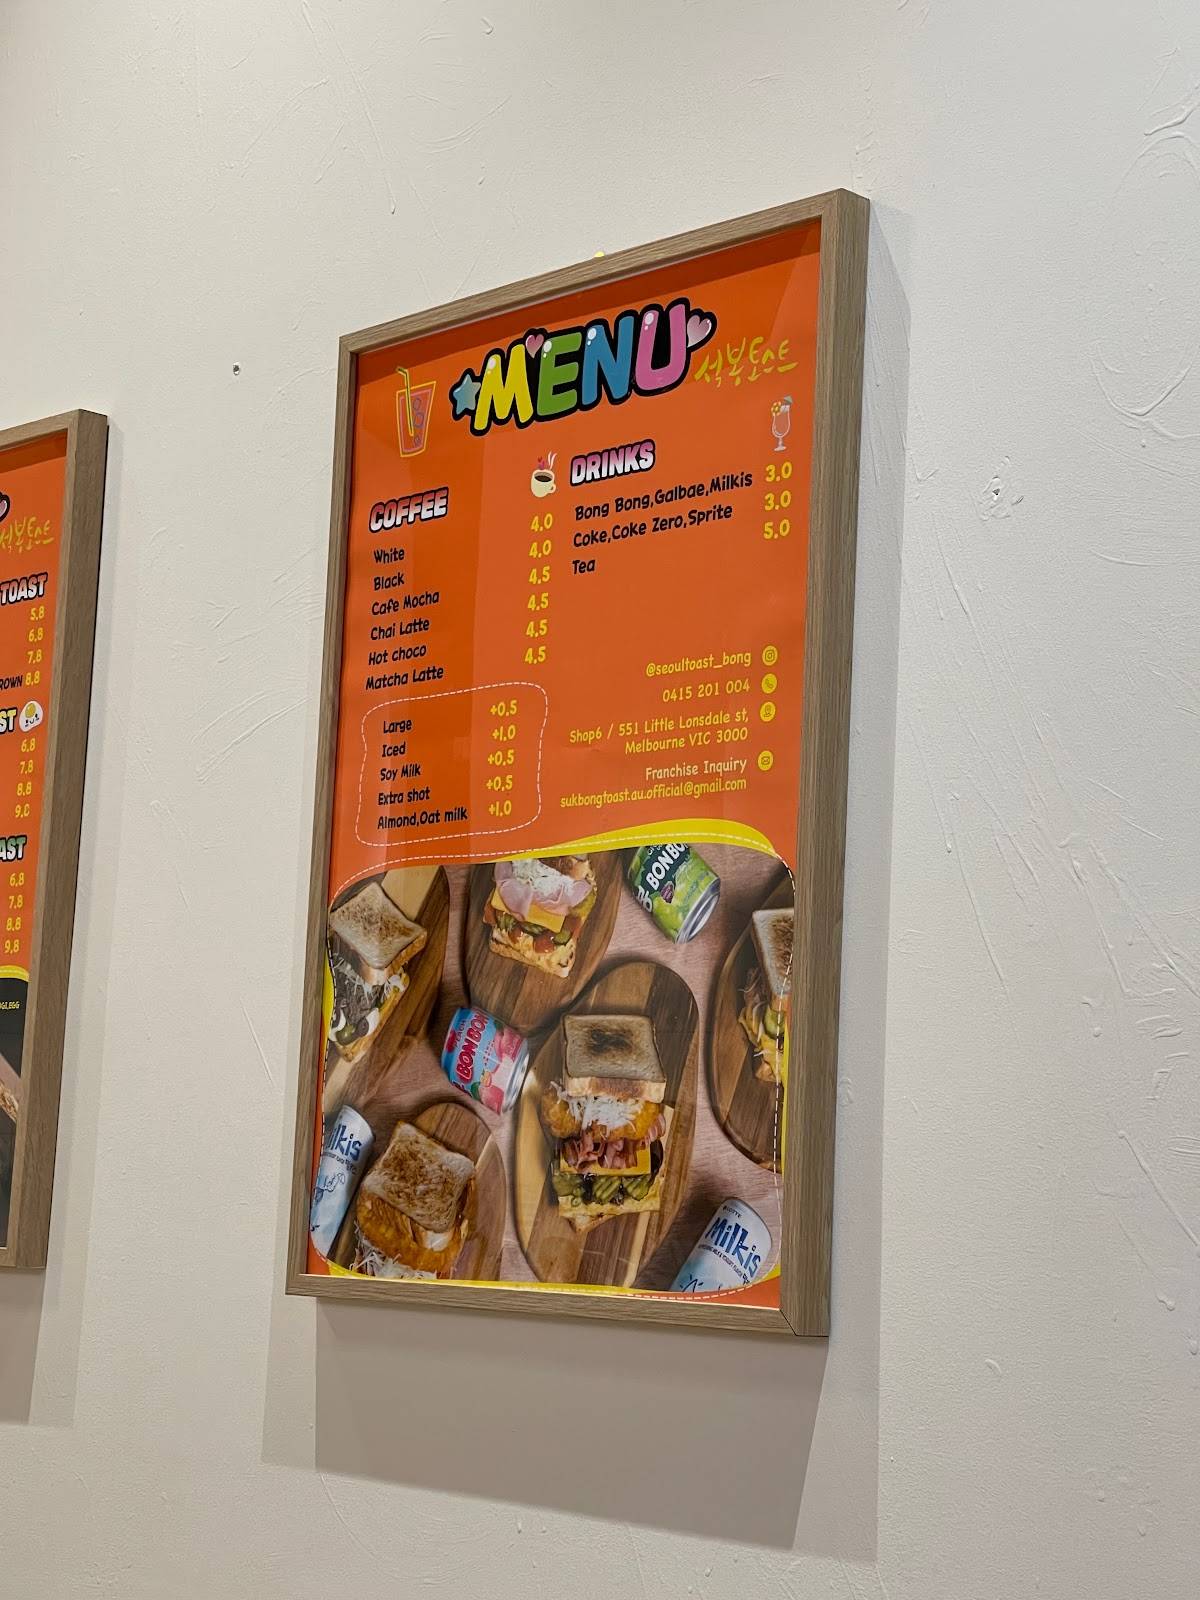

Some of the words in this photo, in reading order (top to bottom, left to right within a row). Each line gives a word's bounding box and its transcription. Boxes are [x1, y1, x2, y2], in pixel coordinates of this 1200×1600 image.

[470, 298, 690, 436] MENU
[570, 438, 656, 486] DRINKS
[765, 461, 793, 482] 3.0
[764, 490, 792, 511] 3.0
[369, 487, 449, 533] COFFEE
[575, 501, 610, 521] Bong
[530, 513, 553, 532] 4.0
[763, 519, 790, 539] 5.0
[374, 547, 405, 564] White
[529, 540, 552, 558] 4.0
[528, 566, 551, 585] 4.5
[572, 559, 596, 575] Tea
[0, 572, 48, 605] TOAST
[373, 572, 405, 591] Black
[371, 599, 400, 616] Cafe
[403, 591, 440, 609] Mocha
[527, 593, 549, 611] 4.5
[30, 605, 45, 621] 5.8
[28, 627, 43, 643] 6.8
[370, 623, 396, 641] Chai
[399, 618, 430, 636] Latte
[525, 619, 548, 637] 4.5
[27, 649, 42, 664] 7.8
[368, 650, 388, 666] Hot
[392, 645, 427, 661] choco
[524, 646, 546, 664] 4.5
[645, 652, 751, 678] @seoultoast_bong
[25, 670, 40, 686] 8.8
[365, 671, 408, 691] Matcha
[413, 666, 444, 683] Latte
[663, 686, 692, 703] 0415
[697, 682, 719, 698] 201
[726, 679, 750, 695] 004
[490, 700, 518, 717] +0.5
[383, 719, 412, 734] Large
[492, 725, 516, 742] +1.0
[569, 726, 602, 746] Shop6
[607, 723, 614, 740] /
[619, 722, 639, 738] 551
[644, 718, 675, 734] Little
[679, 711, 730, 729] Lonsdale
[735, 707, 749, 723] st,
[21, 738, 36, 753] 6.8
[381, 742, 406, 758] Iced
[625, 736, 685, 755] Melbourne
[688, 732, 711, 747] VIC
[717, 727, 748, 744] 3000
[19, 760, 33, 774] 7.8
[487, 750, 515, 766] +0.5
[380, 768, 397, 782] Soy
[401, 764, 421, 778] Milk
[645, 763, 699, 781] Franchise
[703, 757, 747, 777] Inquiry
[16, 782, 32, 797] 8.8
[486, 775, 513, 791] +0.5
[378, 791, 404, 806] Extra
[407, 787, 430, 802] shot
[560, 778, 747, 808] sukbongtoast.au.official@gmail.com
[444, 807, 468, 822] milk
[488, 800, 512, 817] +1.0
[9, 872, 24, 887] 6.8
[8, 895, 23, 909] 7.8
[6, 917, 21, 931] 8.8
[4, 940, 20, 954] 9.8
[705, 1217, 761, 1278] Milkis
